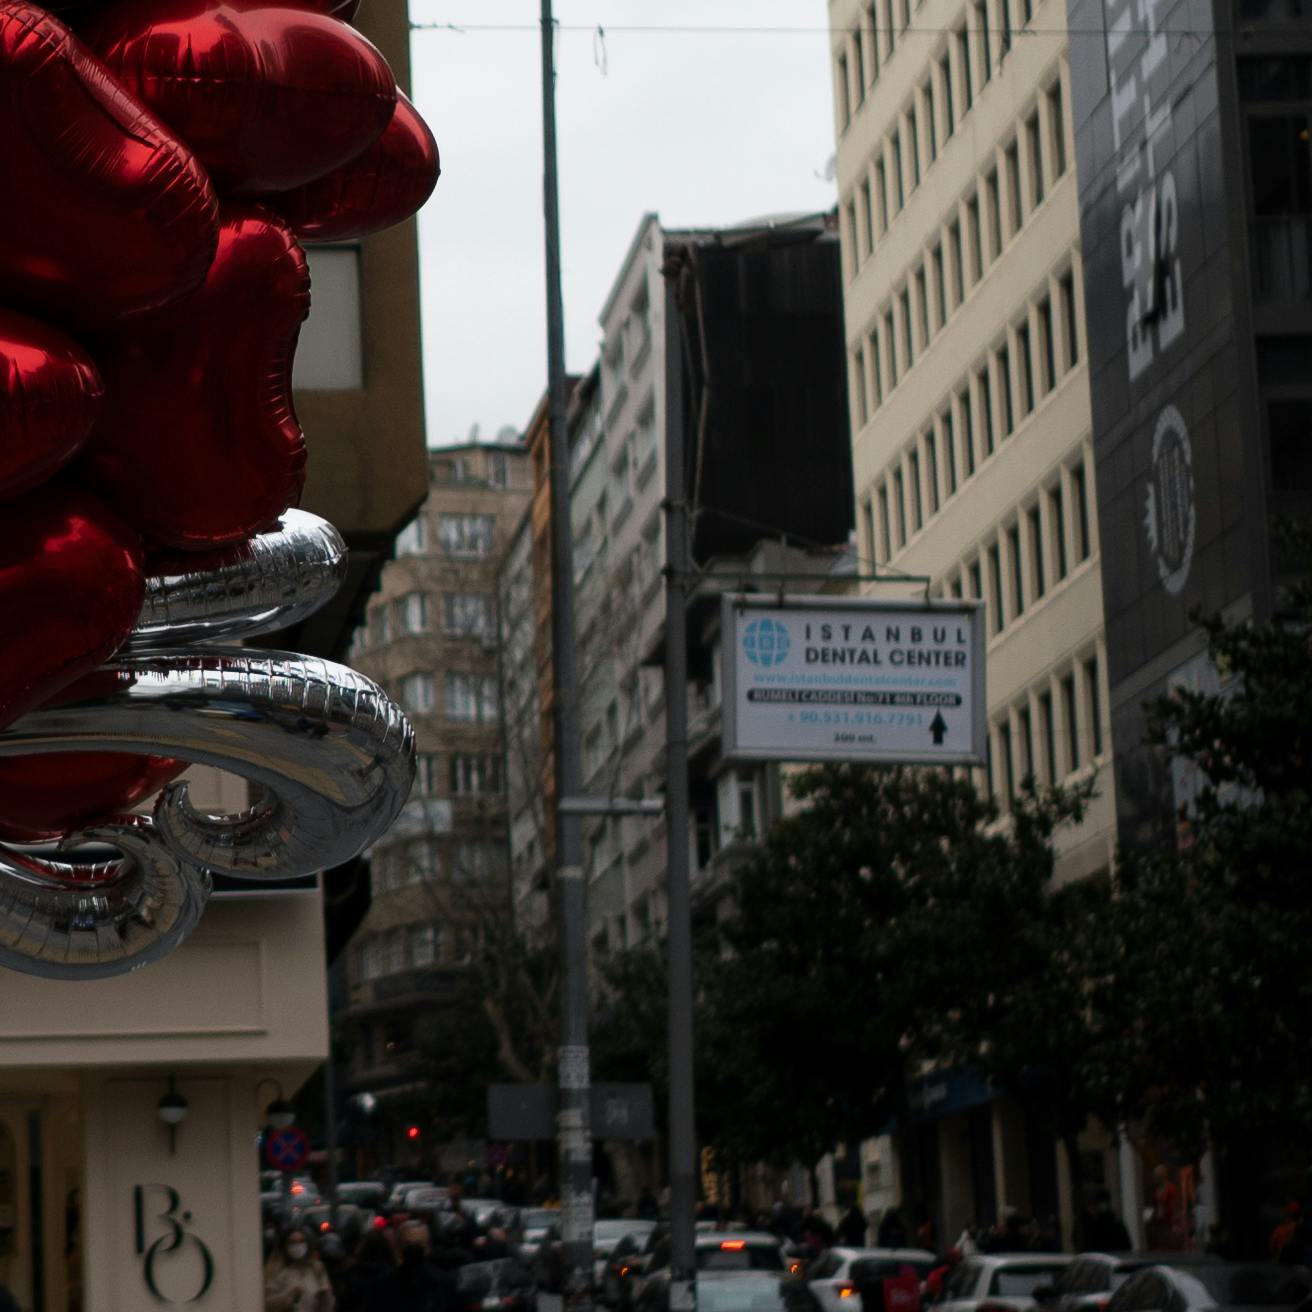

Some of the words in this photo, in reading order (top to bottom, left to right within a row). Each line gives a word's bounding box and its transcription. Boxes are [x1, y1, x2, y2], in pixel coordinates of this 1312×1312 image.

[804, 623, 967, 644] ISTANBUL
[804, 647, 881, 666] DENTAL
[889, 649, 967, 668] CENTER
[916, 692, 956, 705] FLOOR
